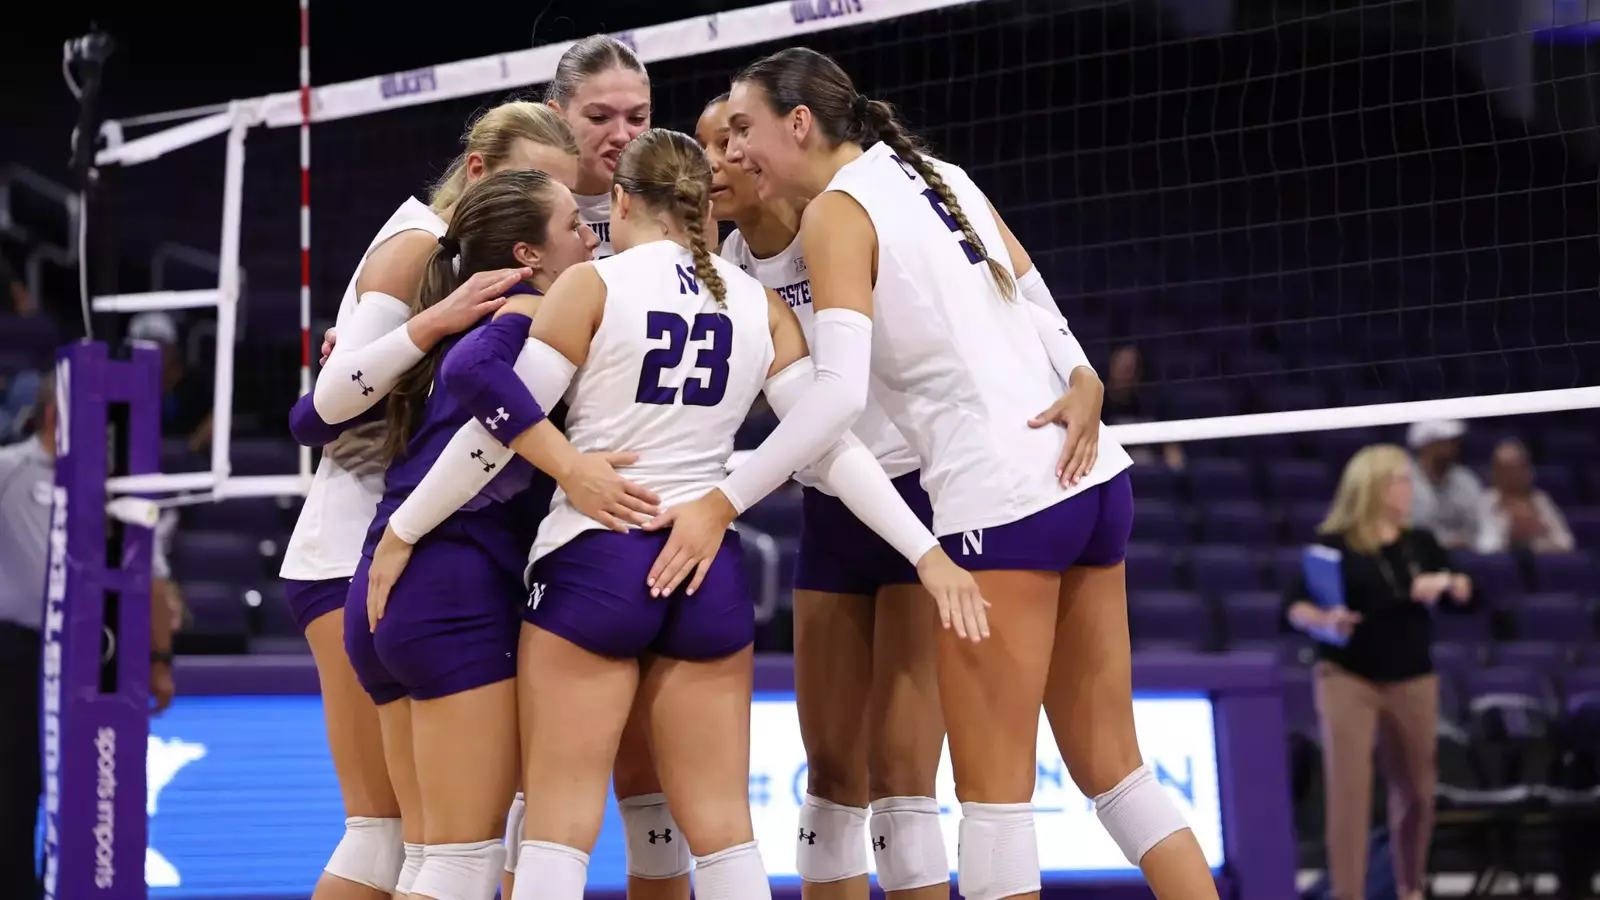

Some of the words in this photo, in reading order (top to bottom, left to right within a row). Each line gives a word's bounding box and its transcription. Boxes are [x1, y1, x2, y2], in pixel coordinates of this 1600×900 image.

[772, 279, 812, 307] ESTE
[635, 310, 733, 406] 23
[962, 529, 983, 556] N
